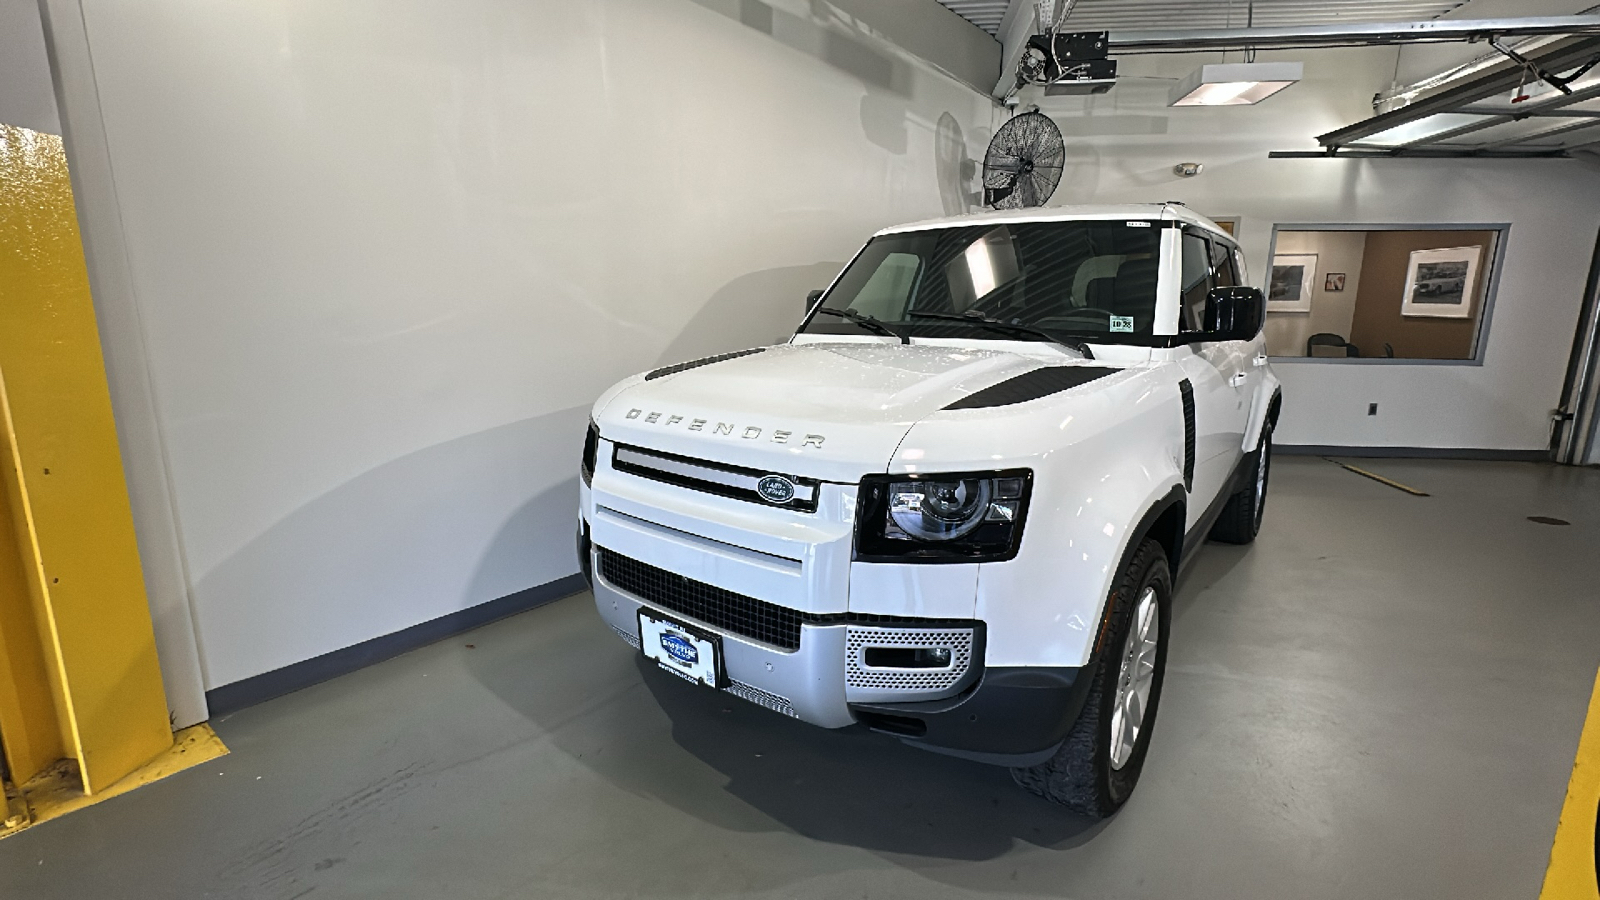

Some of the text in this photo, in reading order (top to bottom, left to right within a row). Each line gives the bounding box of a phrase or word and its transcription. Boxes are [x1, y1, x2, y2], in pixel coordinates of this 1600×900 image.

[624, 407, 827, 449] DEFENDER
[766, 482, 784, 490] LAND
[766, 487, 787, 497] ROVER
